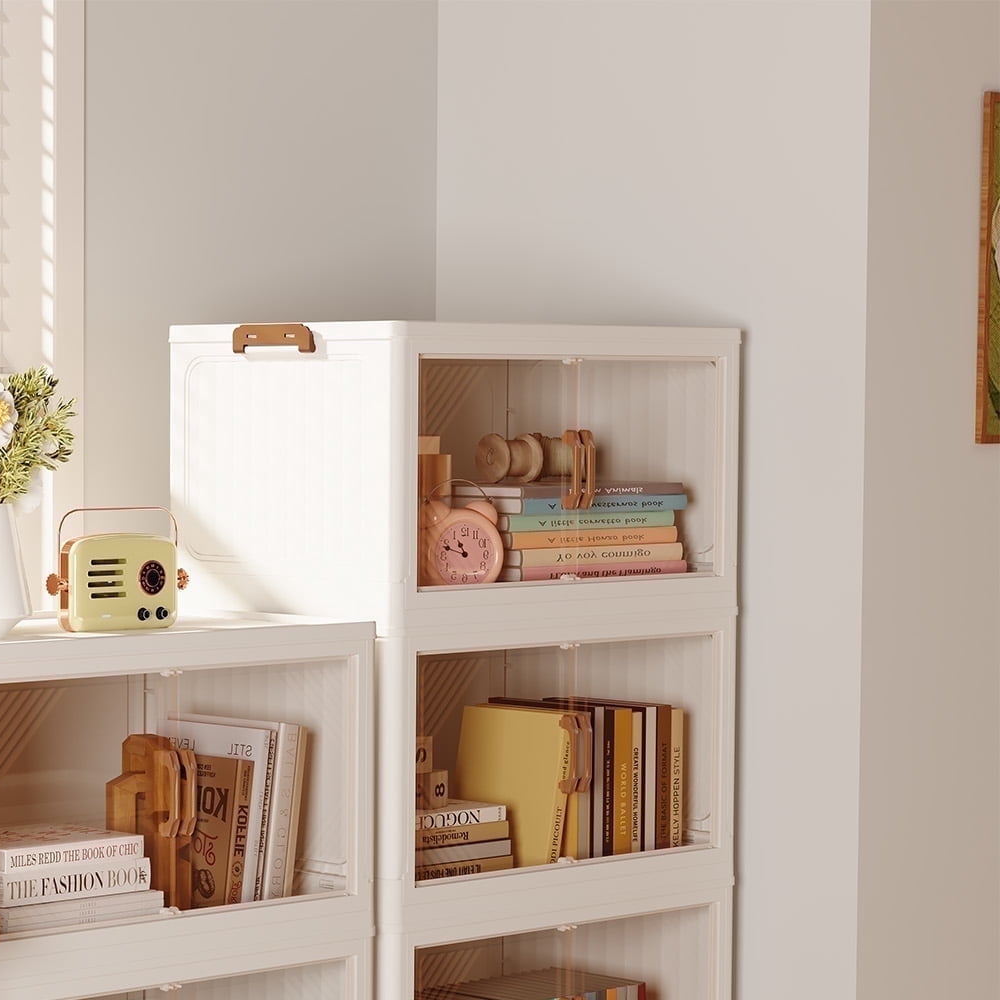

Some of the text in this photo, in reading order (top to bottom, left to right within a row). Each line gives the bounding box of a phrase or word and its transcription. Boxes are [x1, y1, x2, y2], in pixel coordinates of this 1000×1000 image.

[672, 745, 681, 848] KELLY HOPPEN STYLE
[10, 842, 140, 869] MILES REDD THE BOOK OF CHIC
[7, 878, 39, 900] THE
[40, 871, 104, 897] FASHION
